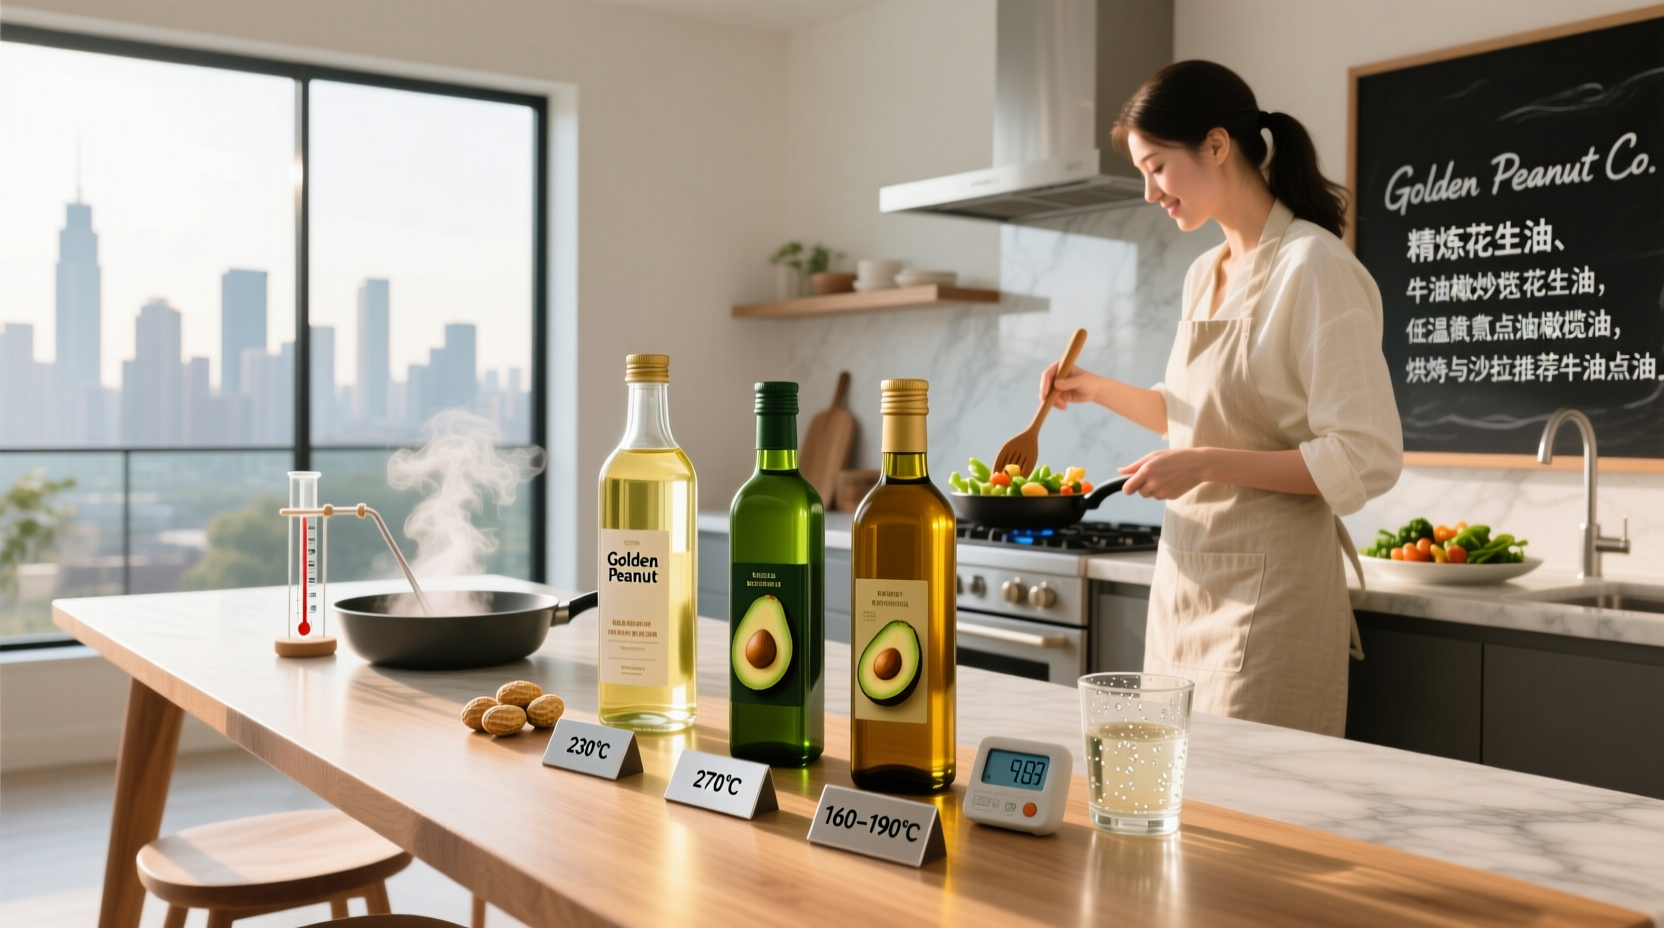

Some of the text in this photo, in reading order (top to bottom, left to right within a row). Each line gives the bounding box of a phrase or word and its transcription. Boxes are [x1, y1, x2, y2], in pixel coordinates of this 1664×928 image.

[1384, 132, 1657, 216] Golden Peanut Co.
[607, 551, 659, 568] Golden
[608, 567, 658, 583] Peanut
